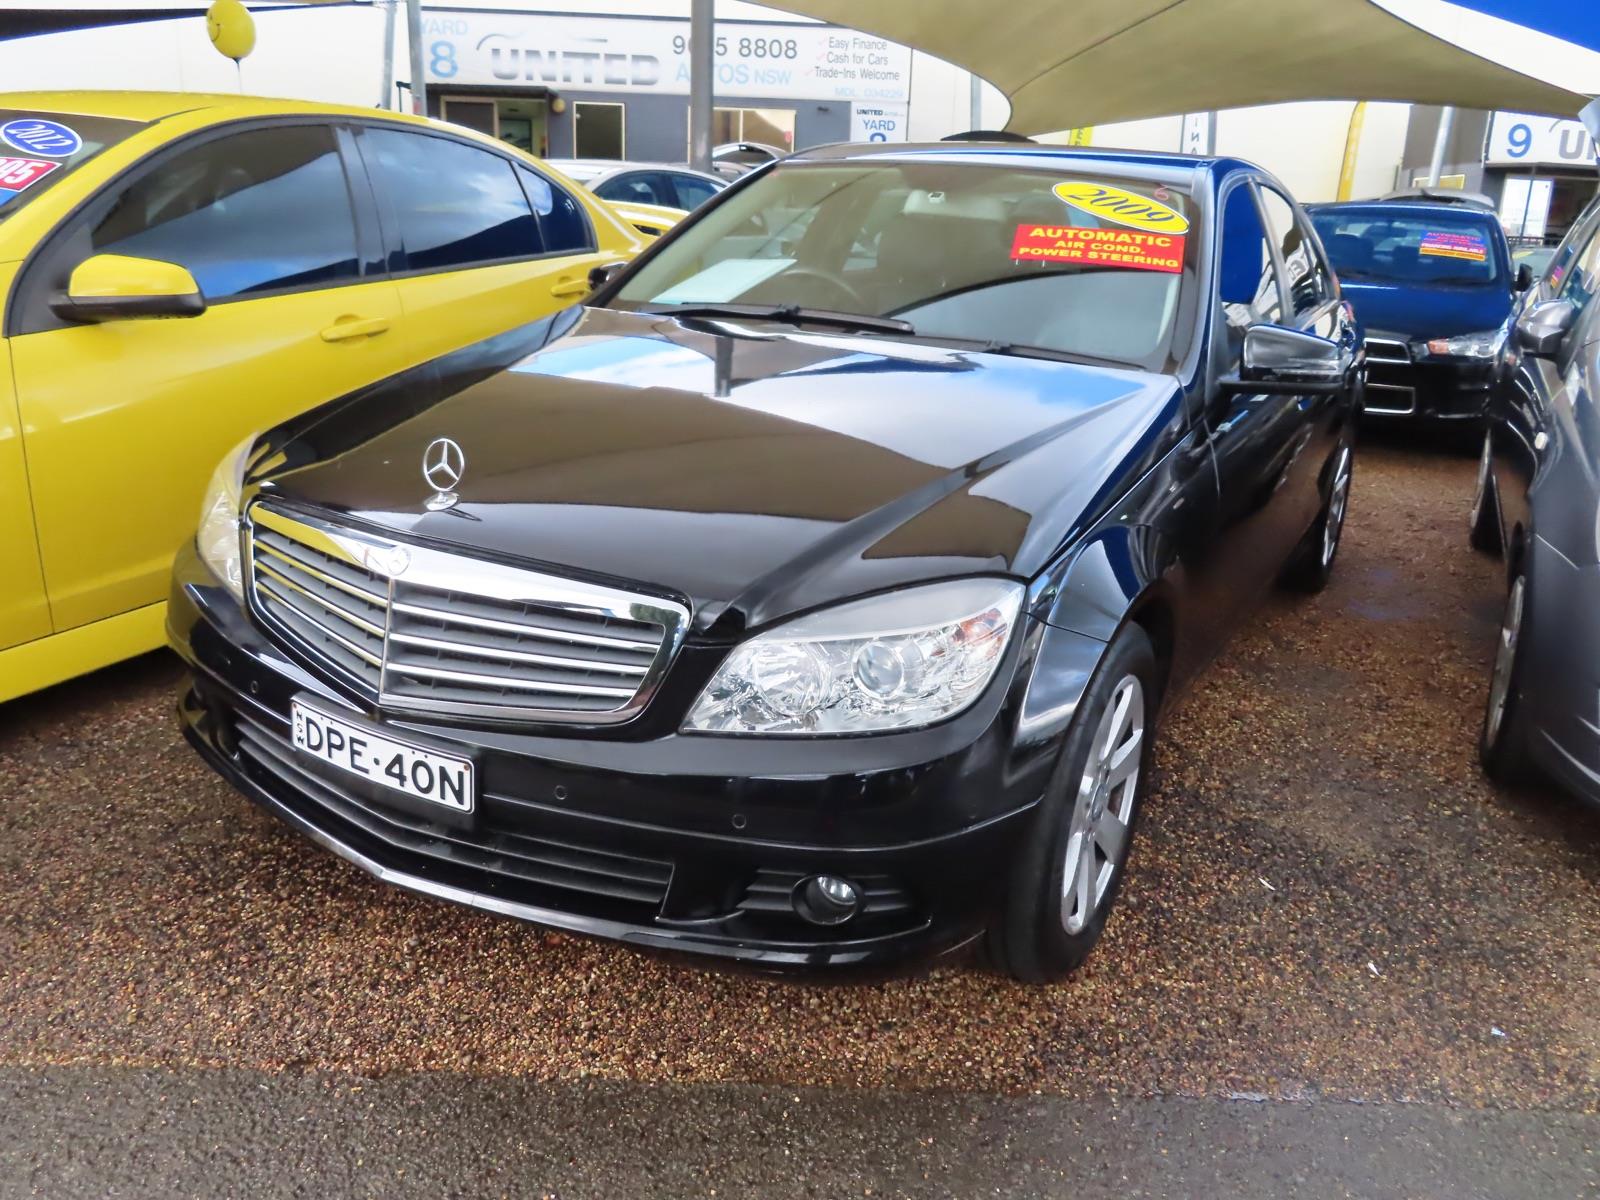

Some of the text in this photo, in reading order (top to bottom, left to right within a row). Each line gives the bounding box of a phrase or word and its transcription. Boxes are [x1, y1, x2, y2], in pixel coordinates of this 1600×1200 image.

[672, 35, 798, 60] 95 8808
[828, 36, 888, 51] Easy Finance
[430, 40, 459, 78] 8
[491, 47, 661, 86] UNITED
[754, 68, 792, 86] NSW
[826, 51, 889, 67] Cash for Cars
[815, 65, 901, 81] Trade-Ins Welcome
[856, 108, 884, 116] UNITED
[862, 119, 896, 132] YARD
[6, 124, 74, 150] 2012
[1506, 122, 1533, 158] 9
[1067, 188, 1177, 222] 2009
[1029, 227, 1173, 248] AUTOMATIC
[1054, 240, 1146, 255] AIR COND.
[1018, 247, 1180, 268] POWER STEERING
[296, 710, 305, 745] NSW
